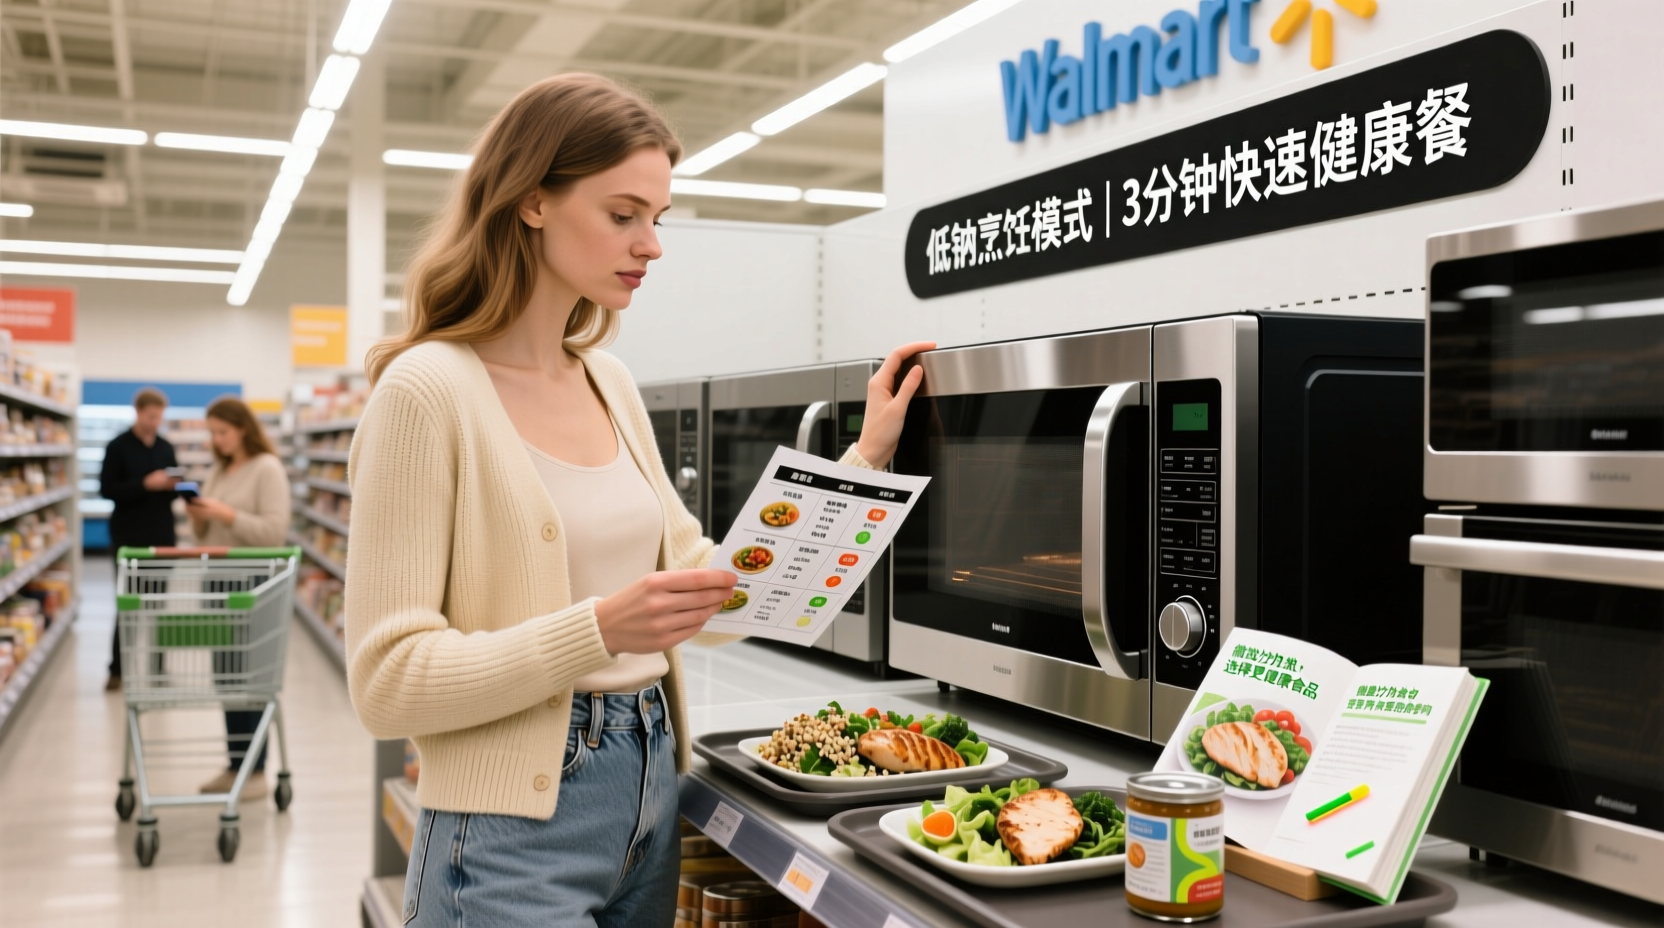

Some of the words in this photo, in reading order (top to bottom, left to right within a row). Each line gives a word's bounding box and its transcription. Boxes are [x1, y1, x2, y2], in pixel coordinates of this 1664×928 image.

[1000, 0, 1260, 143] Walmart
[926, 188, 1093, 275] 低钠烹饪模式
[1122, 82, 1472, 226] 3分钟快速健康餐
